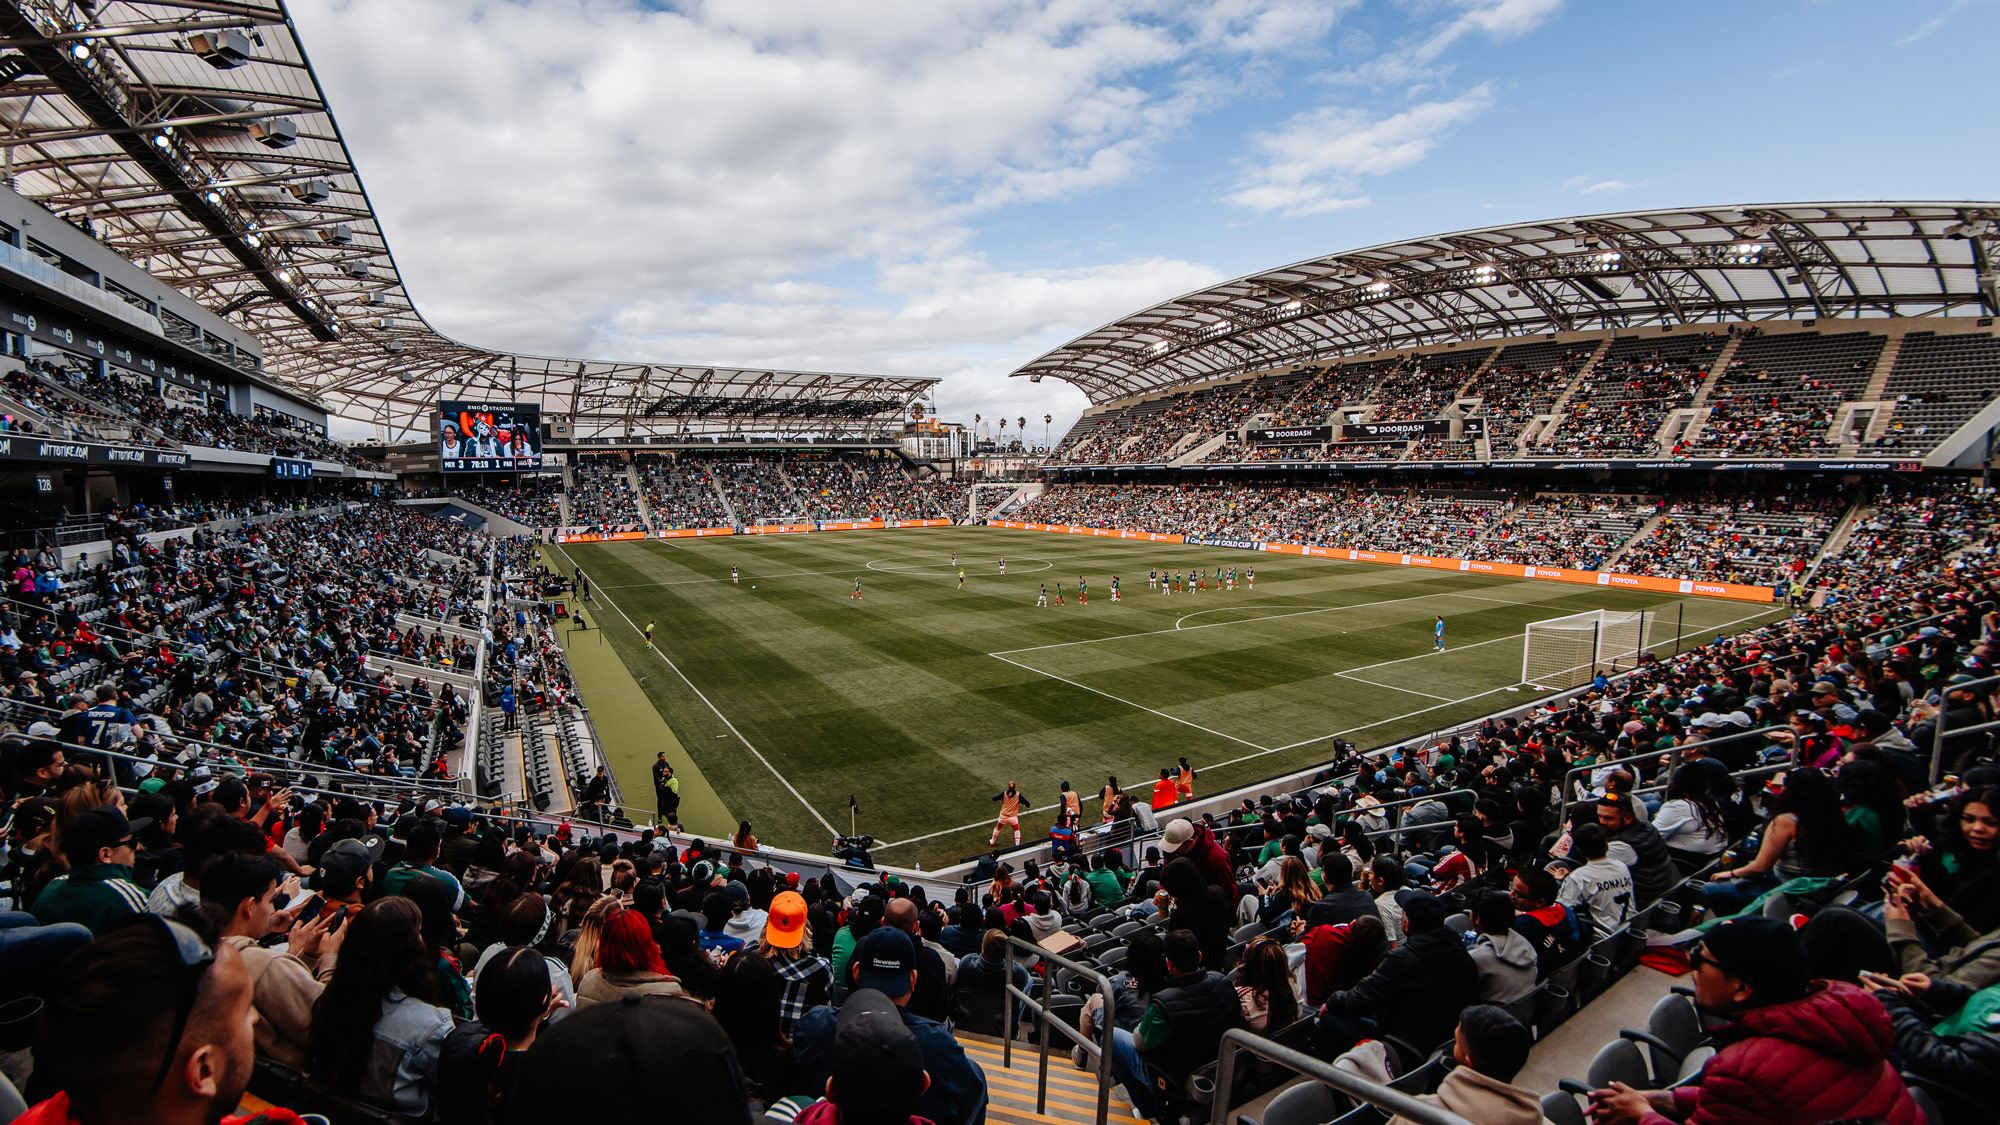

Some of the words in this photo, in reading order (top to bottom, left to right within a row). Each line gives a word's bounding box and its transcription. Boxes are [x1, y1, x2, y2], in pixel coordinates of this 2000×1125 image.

[1380, 424, 1424, 432] DOORDASH
[458, 460, 464, 468] 3
[496, 460, 500, 468] 1
[38, 479, 52, 491] 128
[1695, 585, 1726, 593] TOYOTA
[92, 720, 106, 744] 7
[1614, 891, 1630, 926] 7
